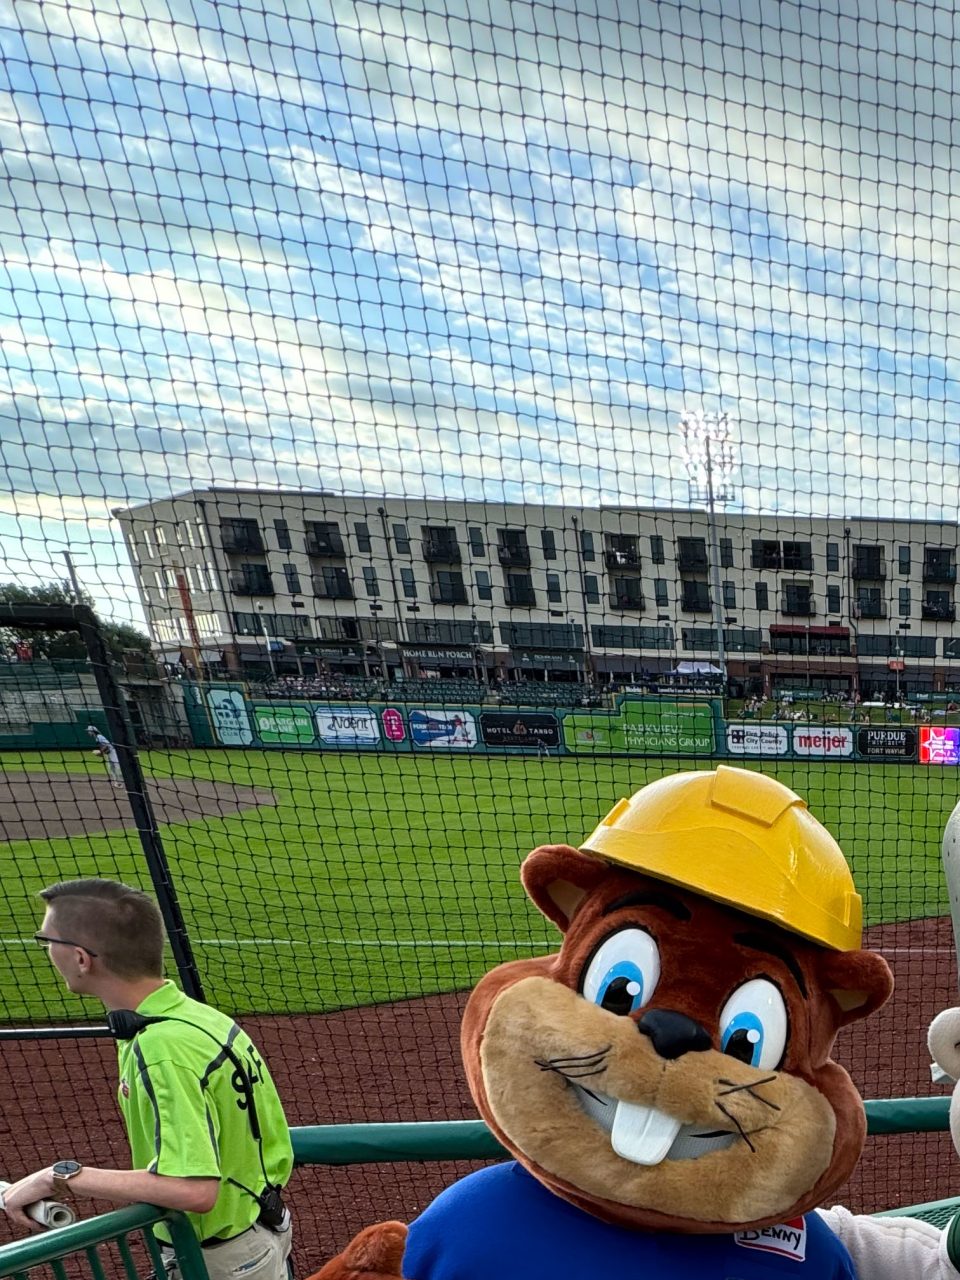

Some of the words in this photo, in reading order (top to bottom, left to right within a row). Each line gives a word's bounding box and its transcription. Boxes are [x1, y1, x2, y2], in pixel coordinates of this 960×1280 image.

[623, 723, 683, 735] PARKVIEW
[798, 730, 848, 752] meijer
[867, 730, 907, 741] PURDUE
[624, 736, 677, 747] PHYSICIANS
[679, 737, 711, 748] GROUP
[739, 1226, 802, 1251] BENNY
